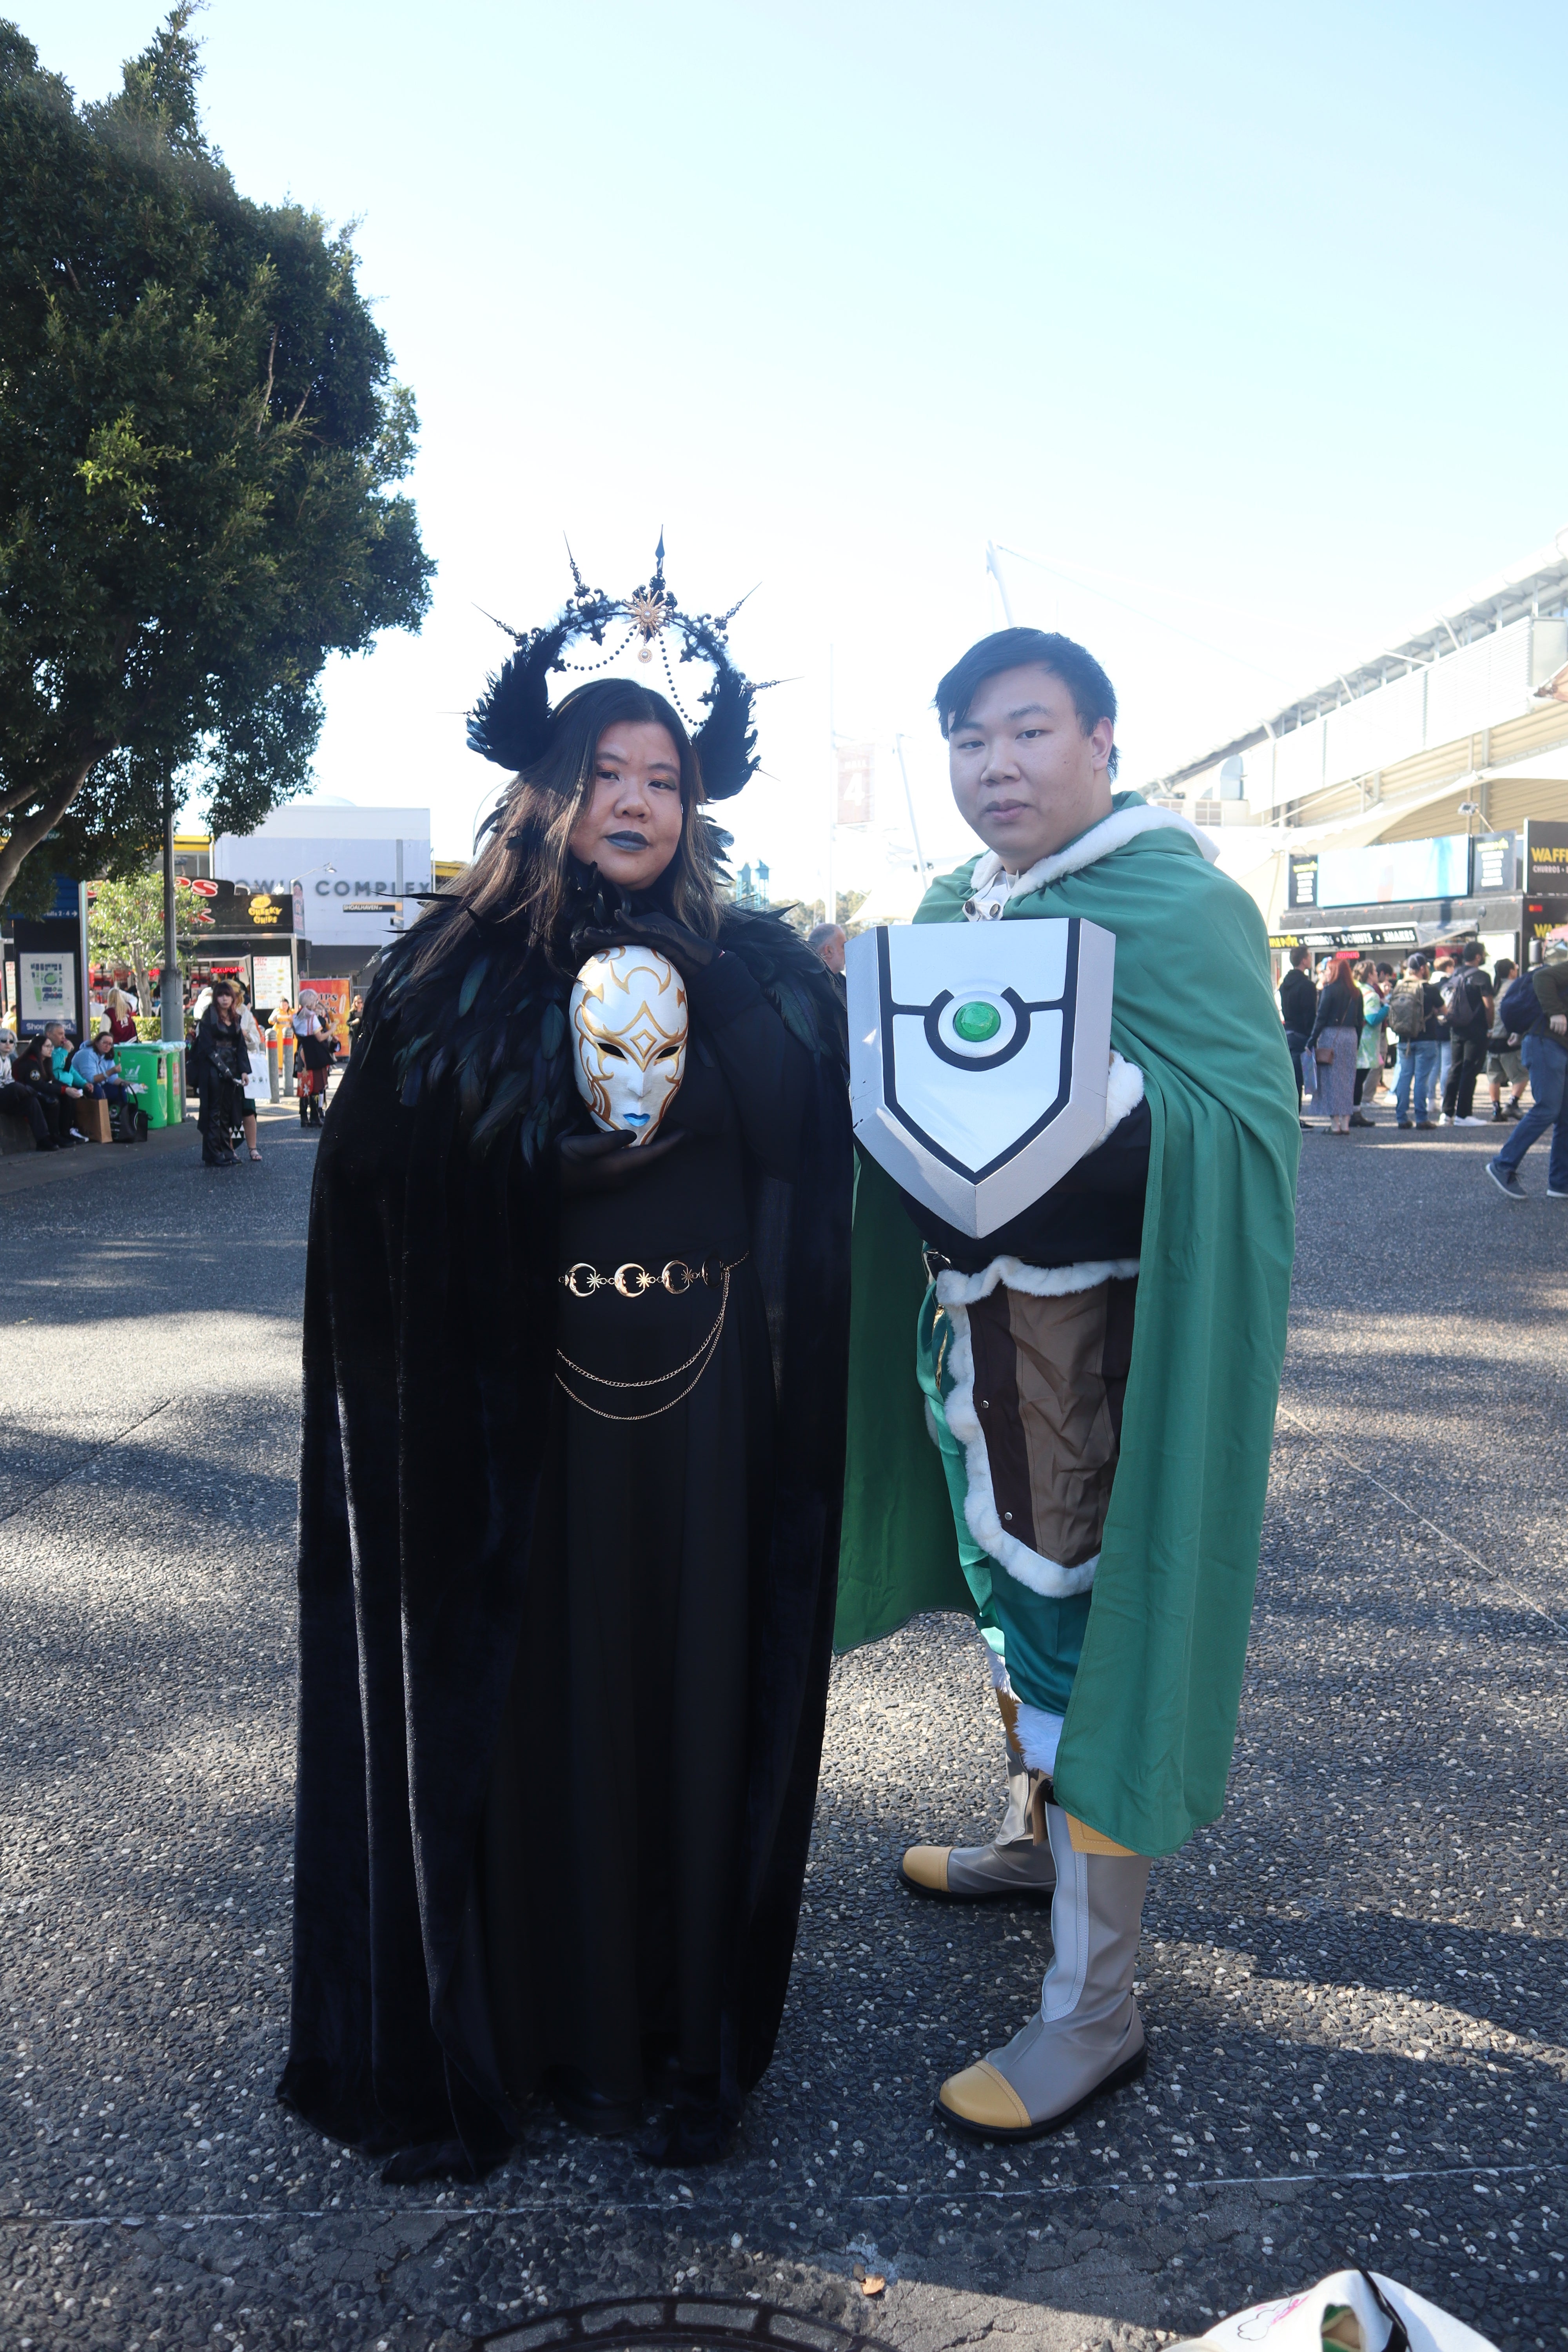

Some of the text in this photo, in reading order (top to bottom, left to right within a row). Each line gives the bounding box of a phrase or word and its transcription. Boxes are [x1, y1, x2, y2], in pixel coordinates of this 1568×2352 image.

[843, 773, 865, 806] 4
[1533, 865, 1560, 874] CHURROS
[248, 906, 283, 916] CHEEKY
[253, 916, 278, 924] CHIPS
[1303, 935, 1334, 946] CHURROS
[1341, 932, 1373, 944] DONUTS
[1382, 930, 1415, 942] SHAKES
